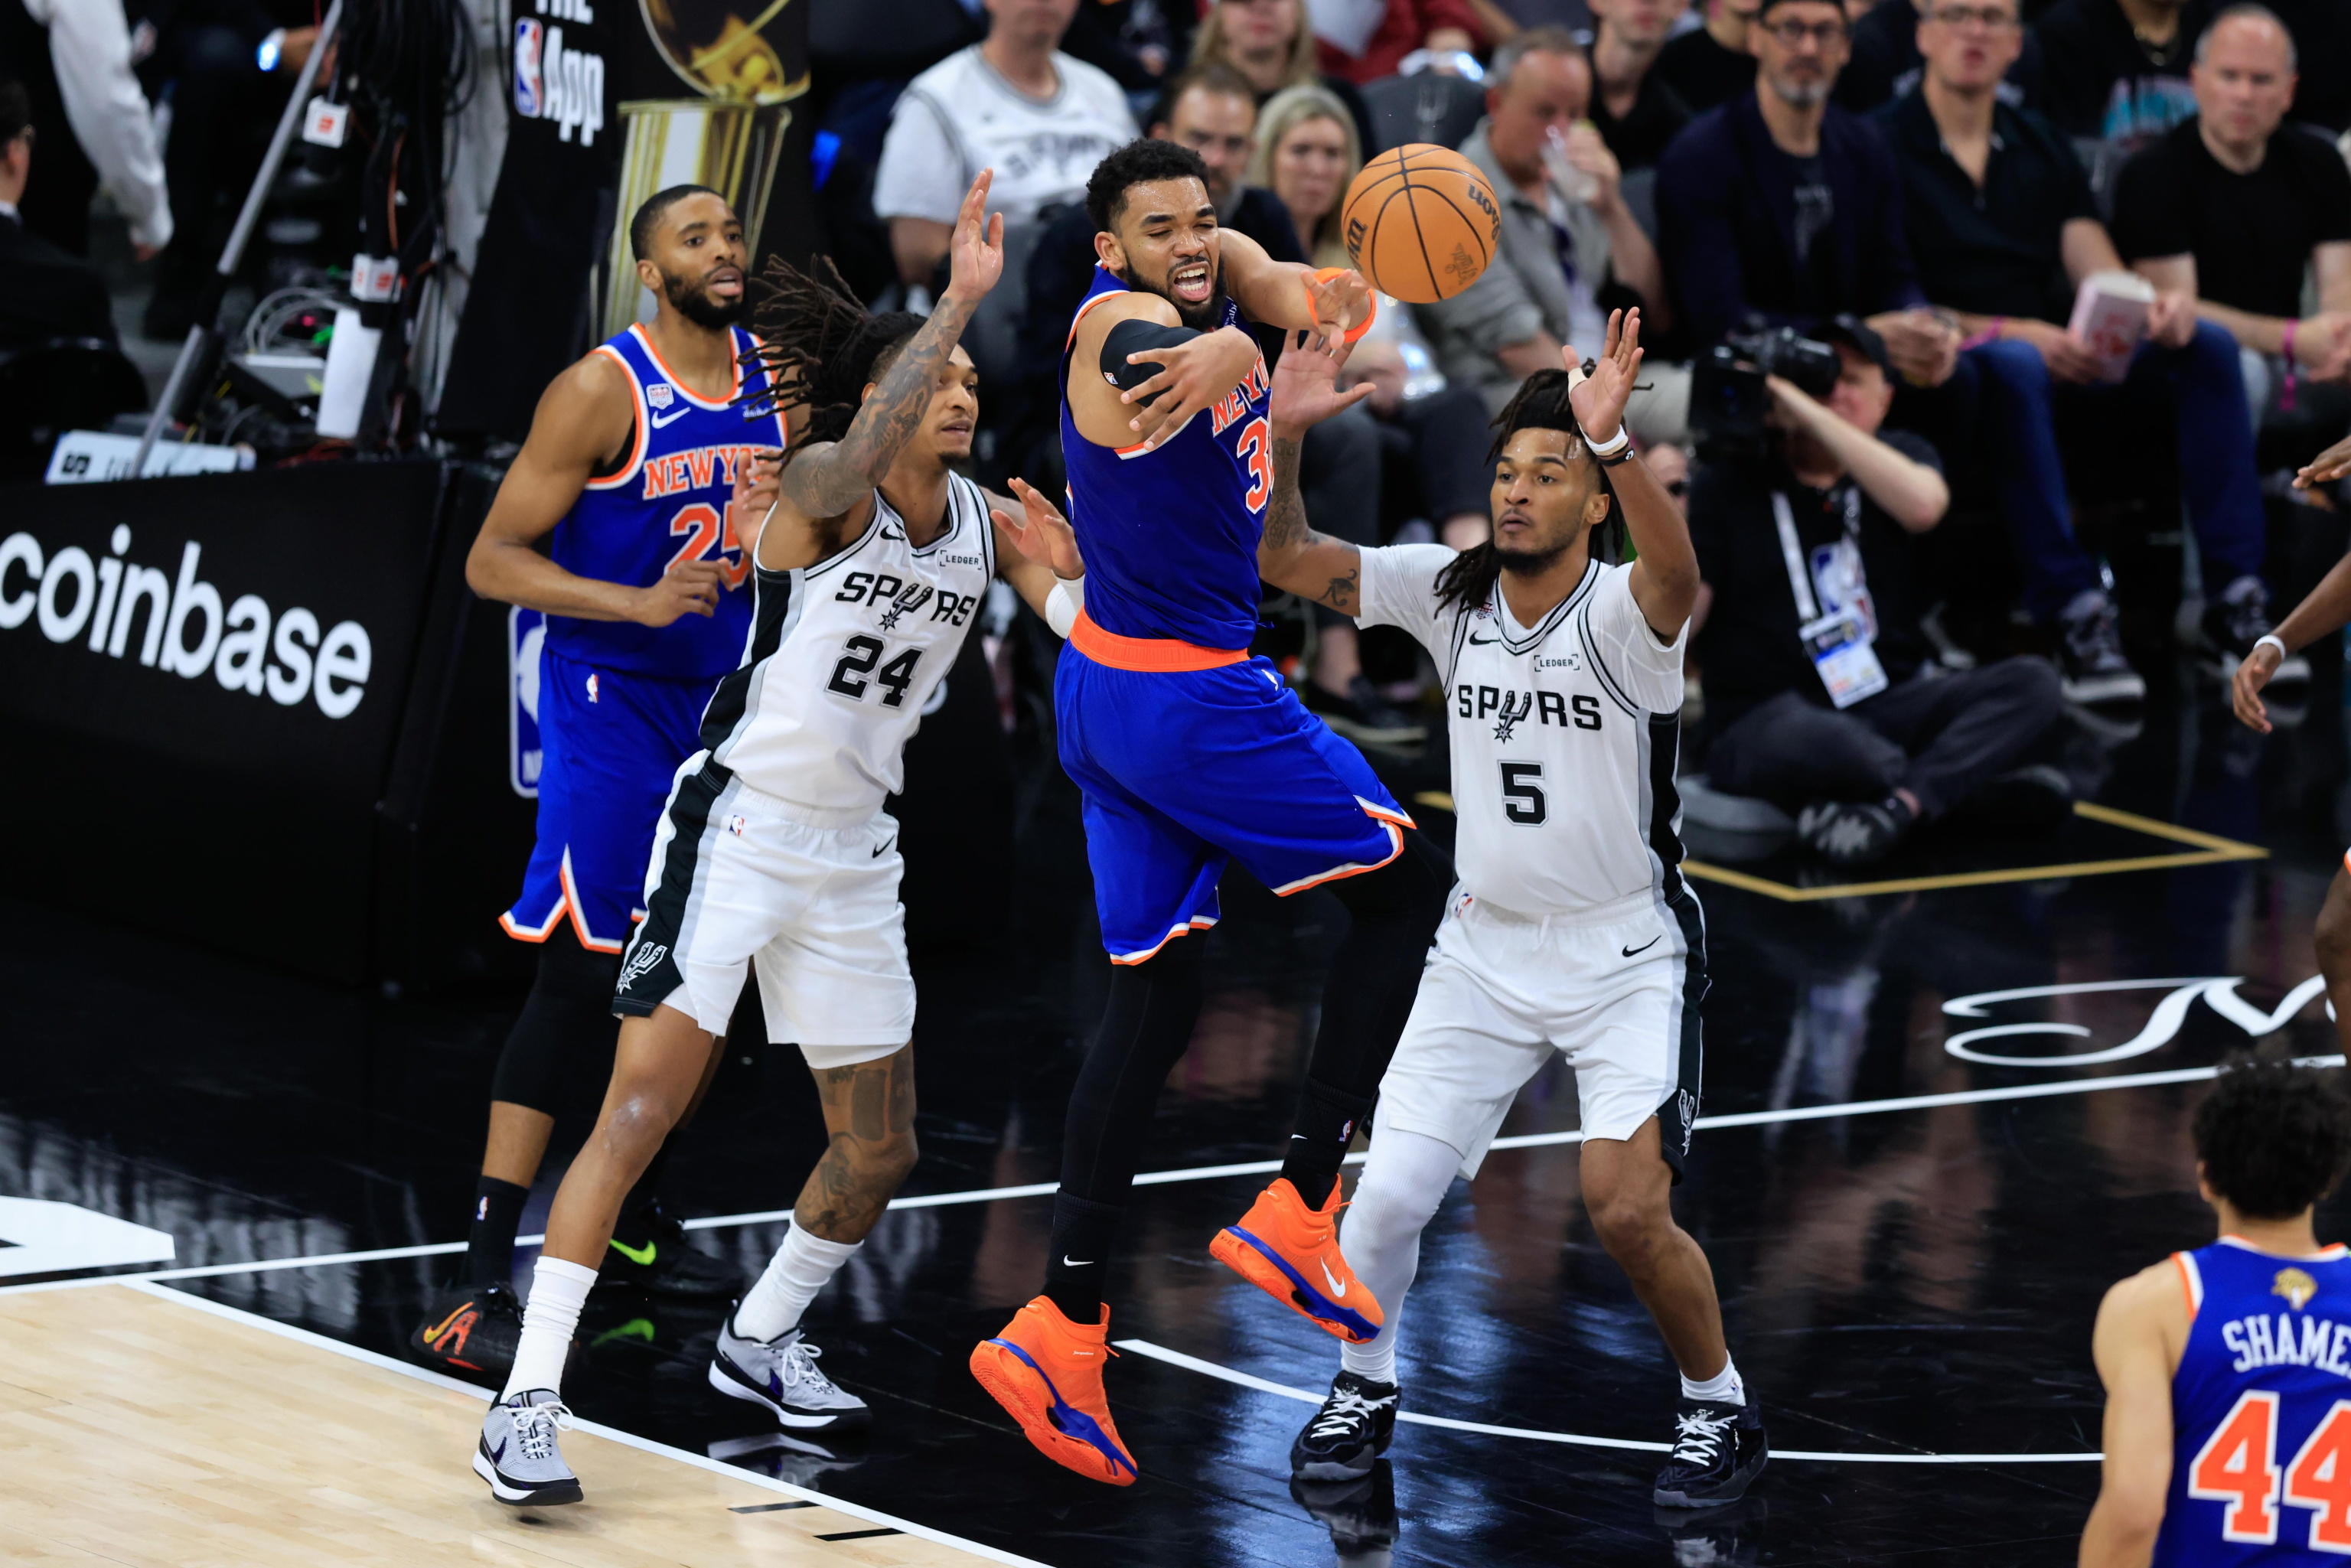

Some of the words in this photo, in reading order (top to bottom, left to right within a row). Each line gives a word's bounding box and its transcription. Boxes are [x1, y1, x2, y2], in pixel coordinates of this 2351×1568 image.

[543, 25, 604, 147] App
[642, 446, 716, 501] NEW
[1236, 416, 1274, 515] 3
[945, 554, 980, 566] LEDGER
[0, 523, 373, 719] coinbase
[835, 572, 977, 631] SPURS
[824, 632, 928, 710] 24
[1539, 658, 1574, 668] LEDGER
[1458, 684, 1603, 744] SPURS
[1497, 759, 1550, 828] 5
[2222, 1312, 2351, 1378] SHAME
[2187, 1388, 2351, 1556] 44
